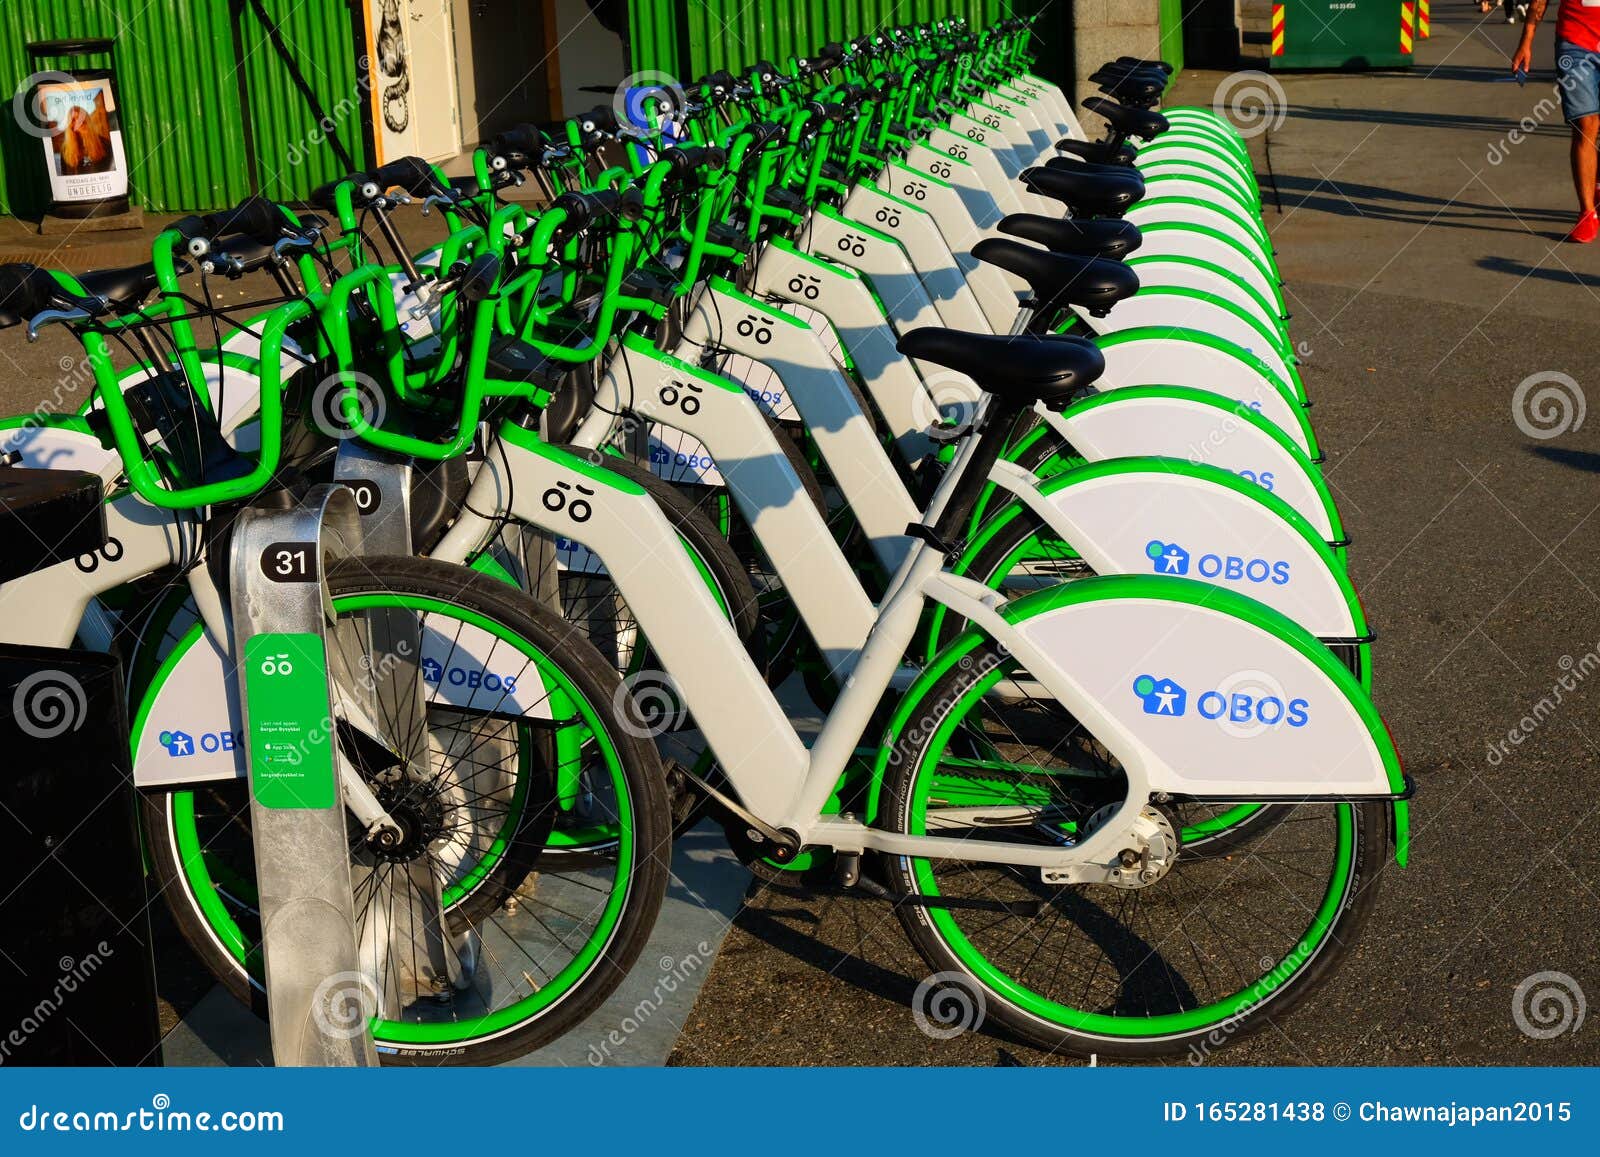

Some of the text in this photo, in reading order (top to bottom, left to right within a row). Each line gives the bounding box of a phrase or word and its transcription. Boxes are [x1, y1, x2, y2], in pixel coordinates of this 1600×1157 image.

[674, 452, 719, 471] OBO
[276, 550, 305, 575] 31
[1198, 554, 1290, 585] OBOS
[448, 667, 517, 695] OBOS
[1197, 691, 1309, 728] OBOS
[200, 731, 245, 753] OB
[400, 1047, 466, 1057] SCHWALBE
